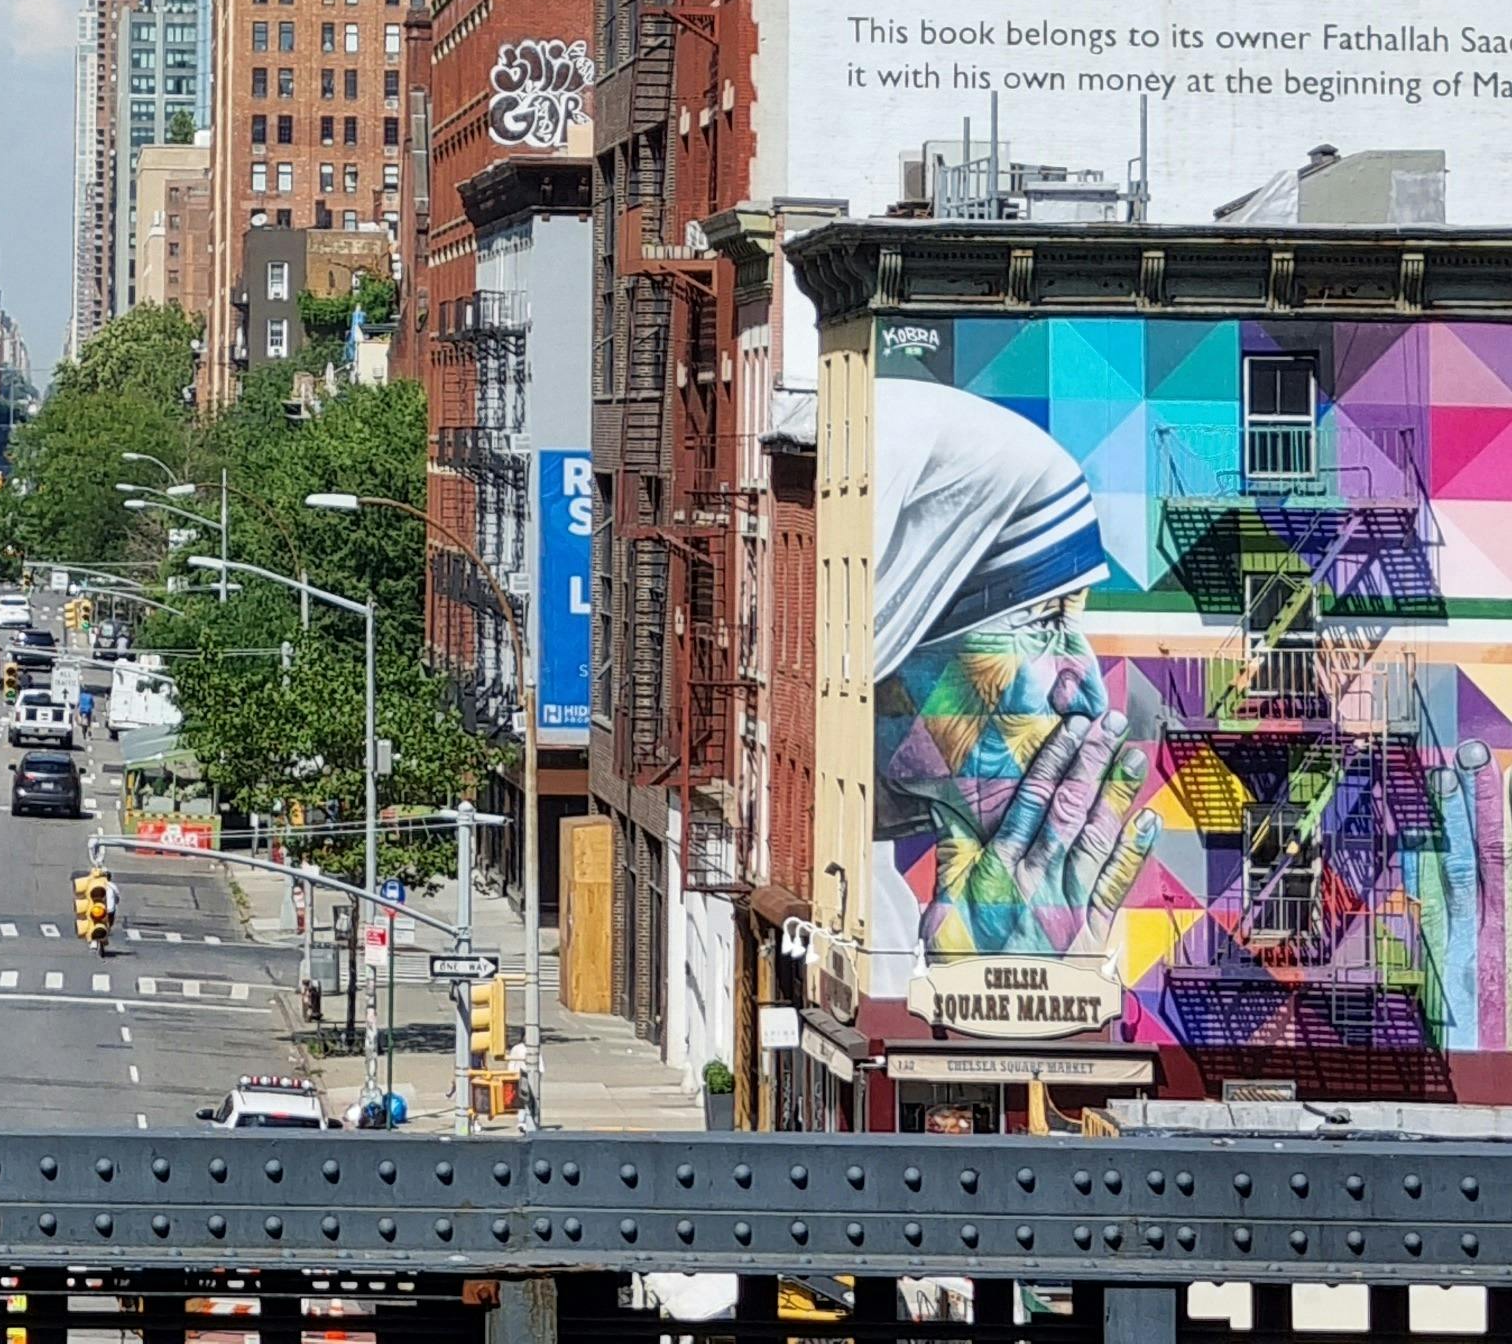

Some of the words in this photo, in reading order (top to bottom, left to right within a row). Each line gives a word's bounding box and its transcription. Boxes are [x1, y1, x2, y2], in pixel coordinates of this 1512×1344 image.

[847, 16, 908, 45] This
[921, 18, 995, 46] book
[1007, 20, 1117, 56] belongs
[1129, 24, 1160, 49] to
[1171, 25, 1204, 50] its
[1216, 30, 1311, 52] owner
[1323, 23, 1449, 53] Fathallah
[847, 63, 866, 88] it
[877, 62, 940, 90] with
[953, 64, 991, 91] his
[1004, 70, 1065, 92] own
[1078, 72, 1176, 100] money
[1187, 70, 1215, 93] at
[1225, 66, 1273, 94] the
[1285, 67, 1422, 104] beginning
[1432, 70, 1463, 97] of
[881, 325, 941, 347] KOBRA
[564, 705, 590, 716] HID
[439, 962, 459, 972] ONE
[468, 962, 489, 972] WAY
[984, 967, 1049, 990] CHELSEA
[932, 993, 1010, 1025] SQUARE
[1016, 995, 1102, 1024] MARKET
[946, 1059, 997, 1073] CHELSEA
[999, 1060, 1045, 1074] SQUARE
[1047, 1061, 1095, 1075] MARKET
